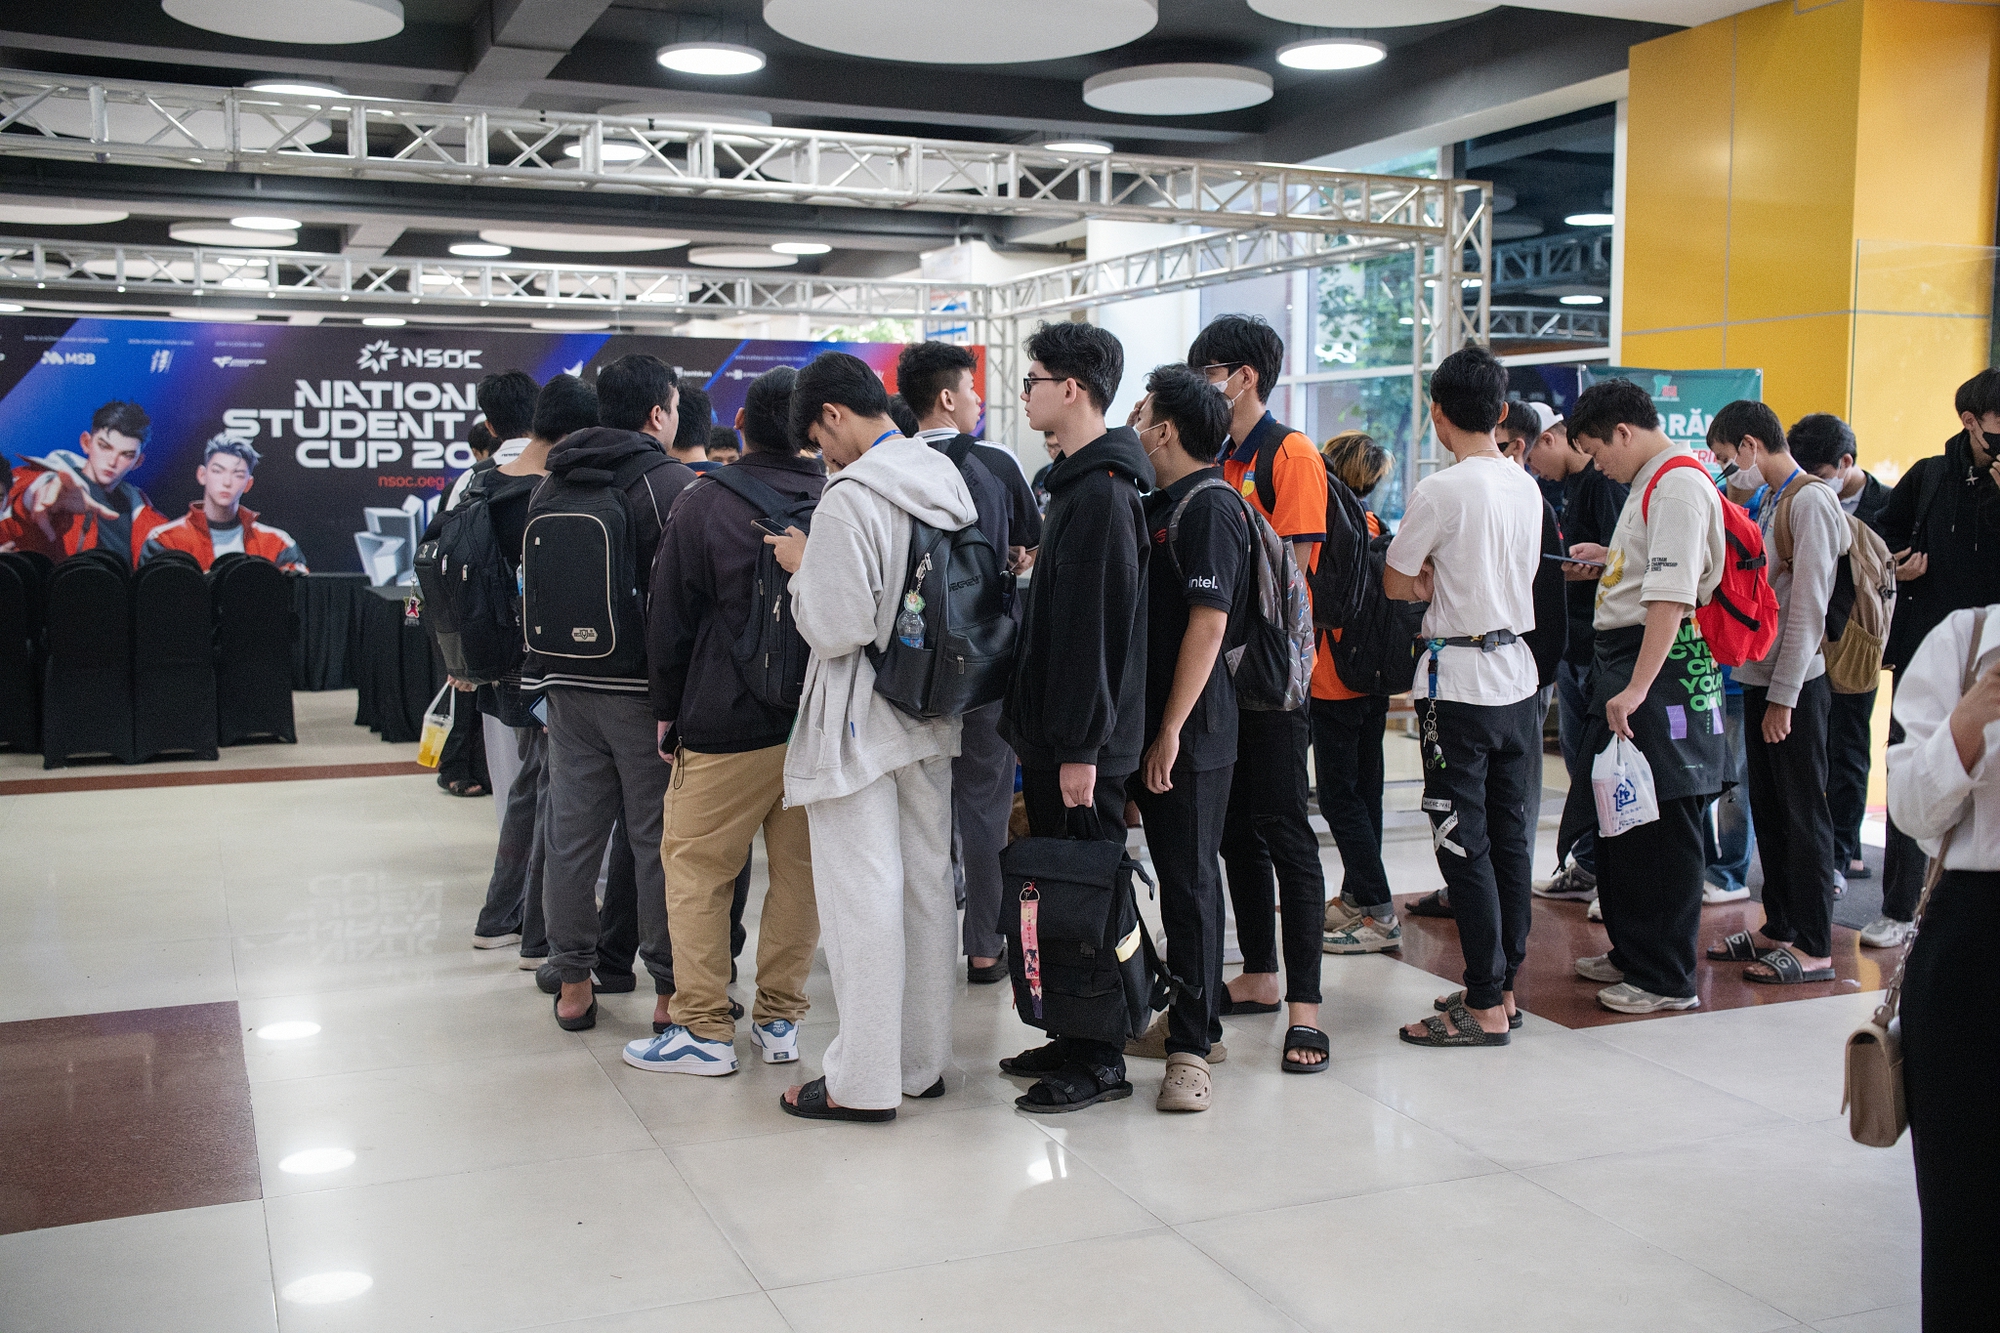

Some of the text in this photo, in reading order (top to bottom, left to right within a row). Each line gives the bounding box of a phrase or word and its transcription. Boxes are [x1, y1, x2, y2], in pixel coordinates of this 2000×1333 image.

[65, 353, 96, 365] MSB
[401, 347, 483, 369] NSOC
[294, 379, 482, 411] NATION
[222, 408, 466, 439] STUDENT
[295, 440, 403, 469] CUP
[1679, 671, 1723, 694] YOUR
